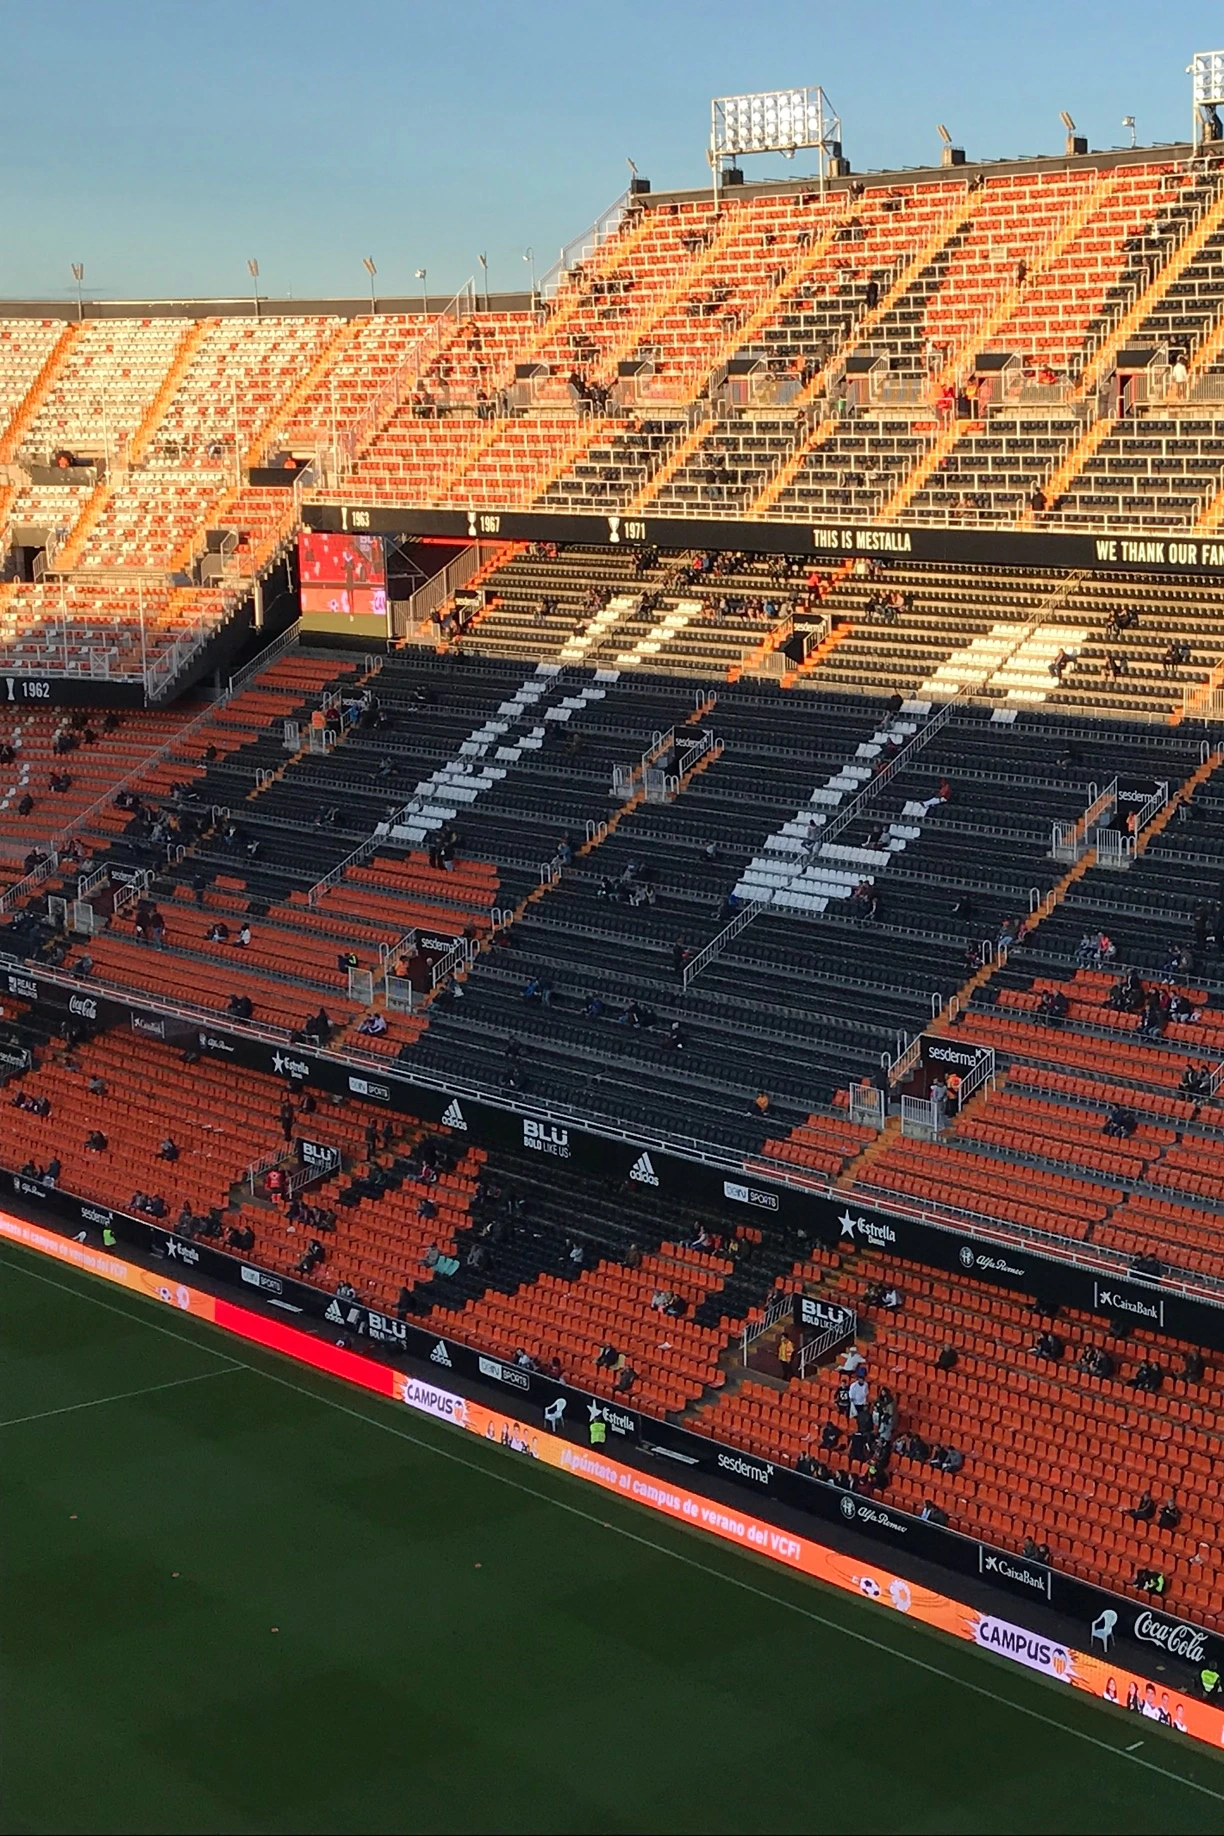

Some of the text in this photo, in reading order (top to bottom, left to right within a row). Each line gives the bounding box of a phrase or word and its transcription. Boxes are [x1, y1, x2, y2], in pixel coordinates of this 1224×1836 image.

[352, 512, 370, 527] 1963
[480, 516, 500, 532] 1967
[624, 522, 646, 539] 1971
[813, 529, 911, 551] THIS IS MESTALLA
[1096, 540, 1118, 561] WE
[1121, 541, 1165, 563] THANK
[1168, 543, 1197, 565] OUR
[22, 682, 50, 698] 1962
[1118, 790, 1158, 804] sesderma
[929, 1047, 976, 1066] sesderma
[442, 1116, 468, 1131] adidas
[524, 1136, 542, 1150] BOLD
[630, 1169, 659, 1187] adidas
[750, 1191, 777, 1208] SPORTS
[857, 1216, 896, 1242] Estrella
[996, 1259, 1025, 1276] Romeo
[1113, 1294, 1158, 1319] CaixaBank
[502, 1369, 528, 1387] SPORTS
[407, 1381, 453, 1414] CAMPUS
[602, 1407, 635, 1431] Estrella
[718, 1453, 769, 1484] sesderma
[619, 1474, 631, 1490] al
[633, 1480, 680, 1510] campus
[683, 1498, 698, 1517] de
[702, 1510, 744, 1536] verano
[747, 1526, 768, 1546] del
[858, 1506, 908, 1534] Alfa Romeo
[998, 1561, 1046, 1591] CaixaBank
[980, 1622, 1050, 1665] CAMPUS
